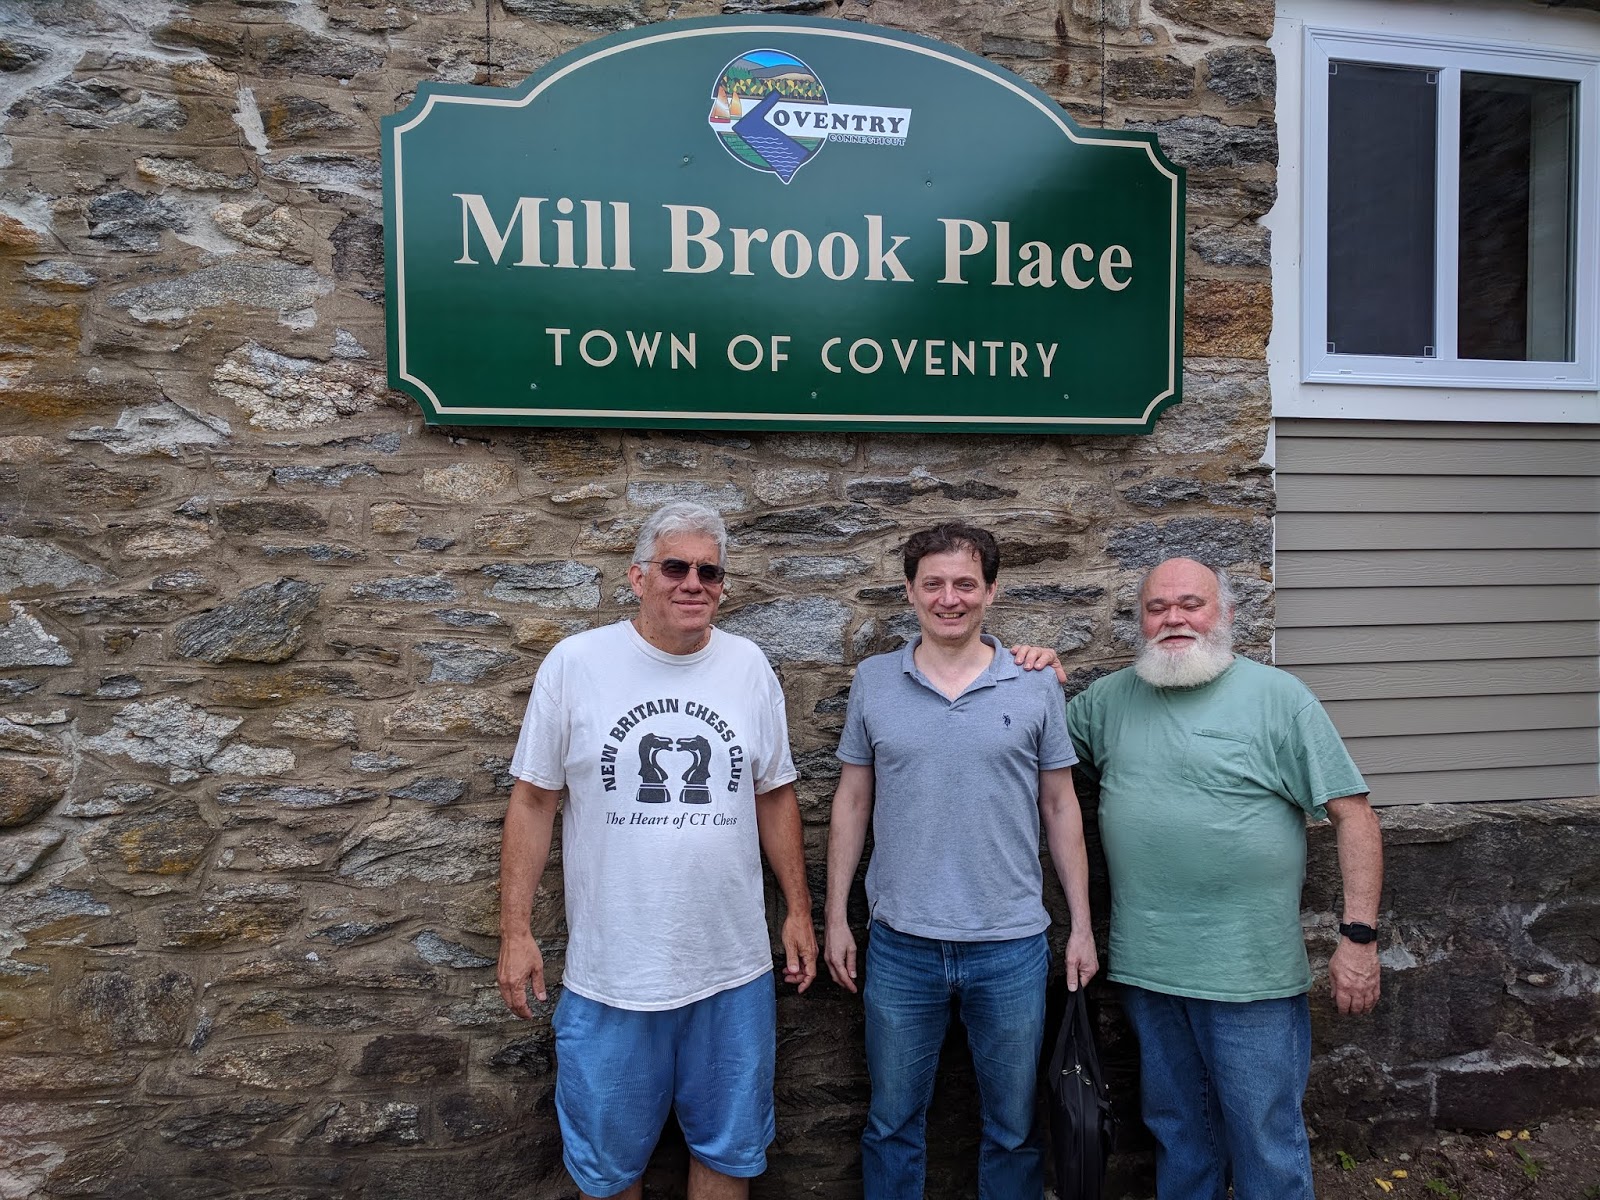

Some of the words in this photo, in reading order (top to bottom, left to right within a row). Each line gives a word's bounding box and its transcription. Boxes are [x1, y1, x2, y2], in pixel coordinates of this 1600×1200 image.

[828, 133, 906, 147] CONNECTICUT
[452, 192, 636, 271] Mill
[662, 204, 914, 282] Brook
[937, 218, 1133, 291] Place
[545, 328, 697, 369] TOWN
[727, 334, 791, 372] OF
[821, 337, 1059, 377] COVENTRY
[609, 698, 679, 743] BRITAIN
[685, 701, 736, 743] CHESS
[600, 743, 619, 792] NEW
[727, 745, 744, 793] CLUB
[605, 812, 625, 825] The
[629, 812, 669, 825] Heart
[672, 812, 688, 829] of
[689, 813, 711, 826] CT
[713, 813, 738, 826] Chess
